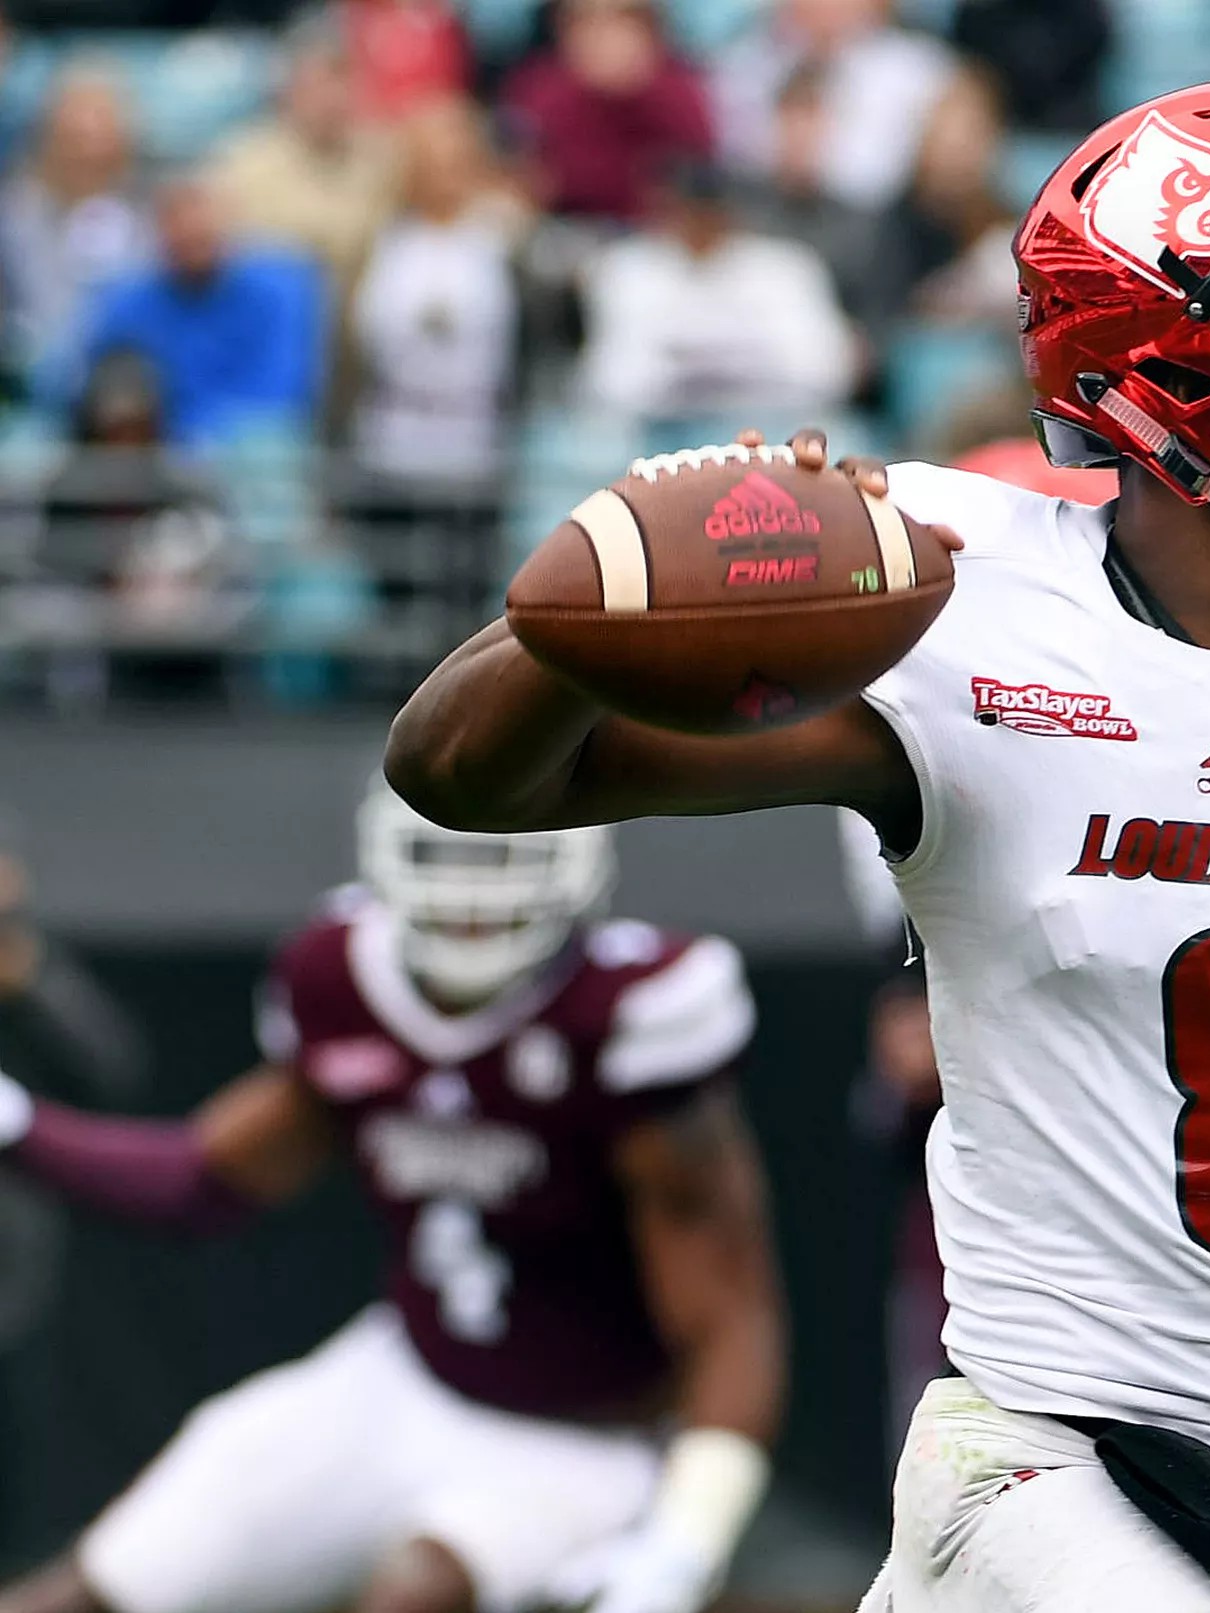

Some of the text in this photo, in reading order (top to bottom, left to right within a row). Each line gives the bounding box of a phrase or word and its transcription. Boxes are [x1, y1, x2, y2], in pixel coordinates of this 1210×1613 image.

[726, 556, 819, 585] DIME
[973, 682, 1109, 720] TaxSlayer
[1072, 717, 1134, 736] BOWL
